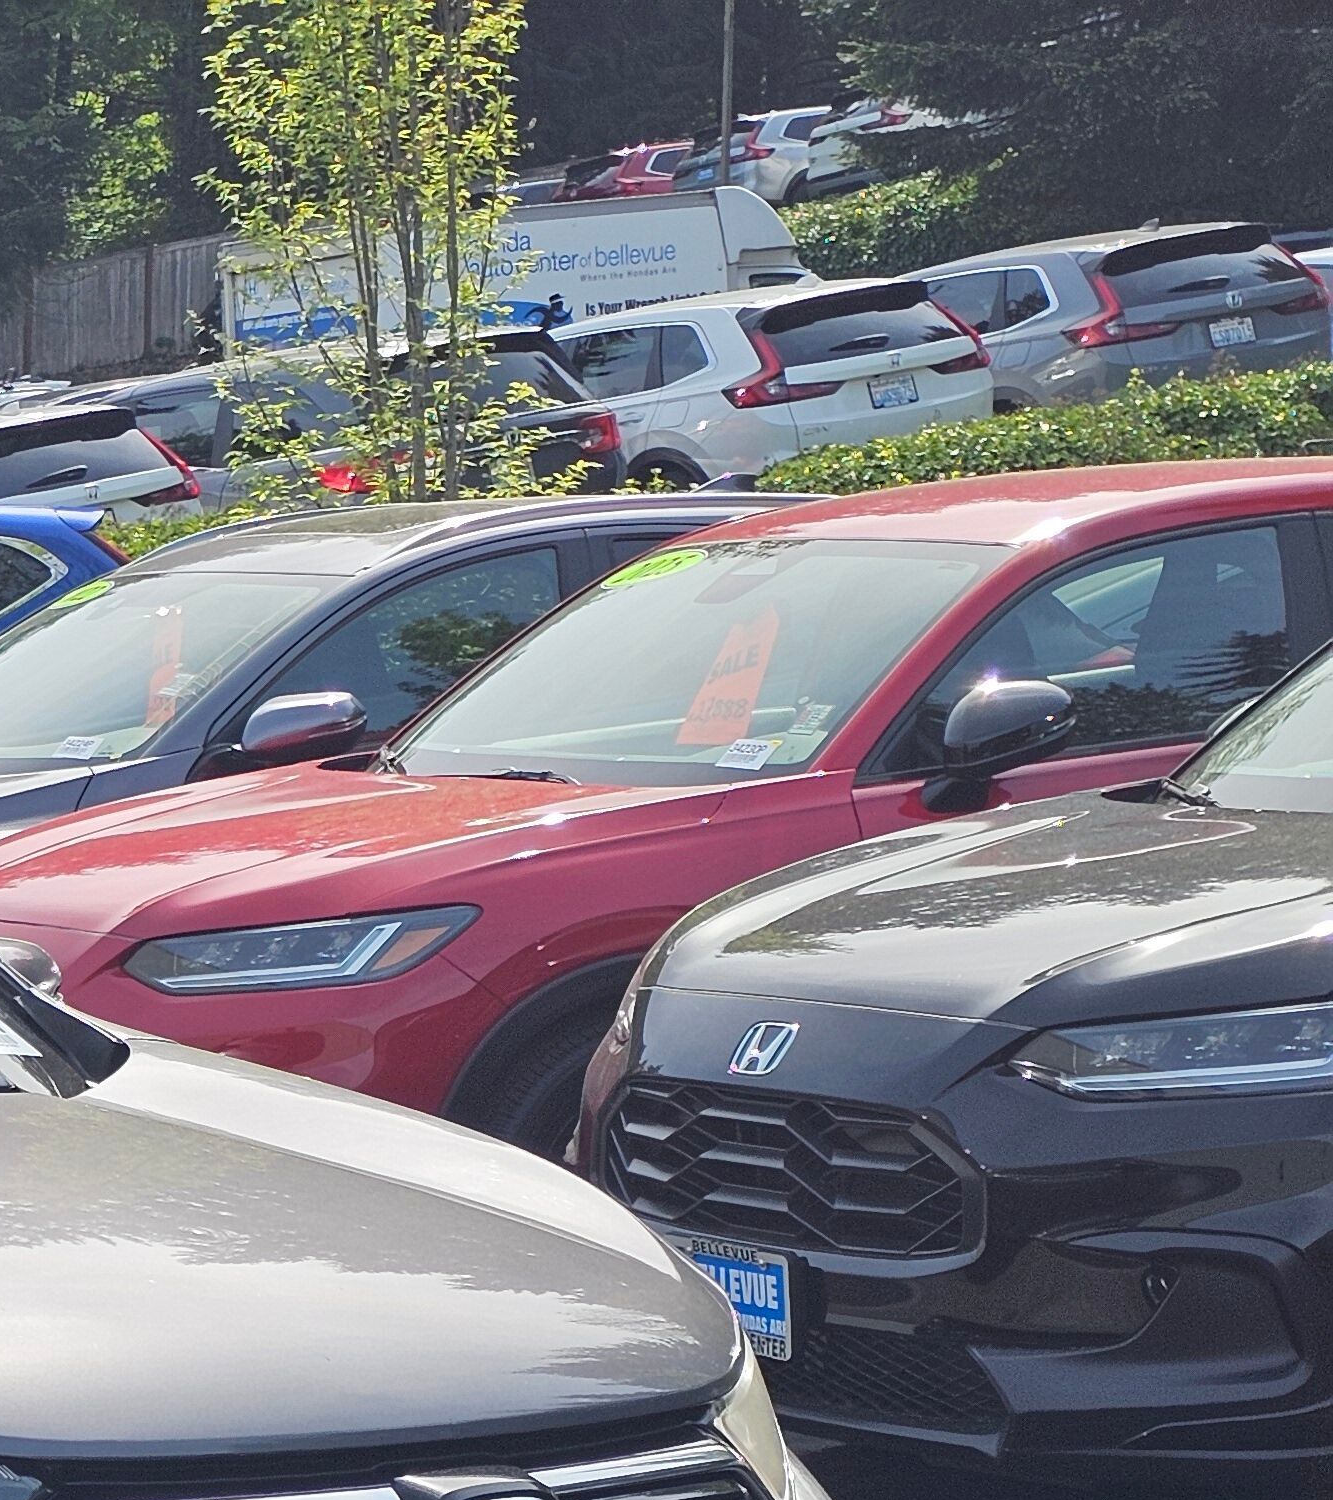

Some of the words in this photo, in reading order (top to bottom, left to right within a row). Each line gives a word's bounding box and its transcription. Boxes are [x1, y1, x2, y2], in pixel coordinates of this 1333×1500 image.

[579, 252, 592, 268] of
[595, 243, 676, 268] bellevue
[627, 268, 659, 278] Hondas
[585, 302, 596, 317] Is
[598, 300, 623, 316] Your
[707, 644, 760, 685] SALE
[692, 1240, 758, 1262] BELLEVUE
[697, 1263, 779, 1310] LEVUE
[750, 1334, 787, 1359] ENTER
